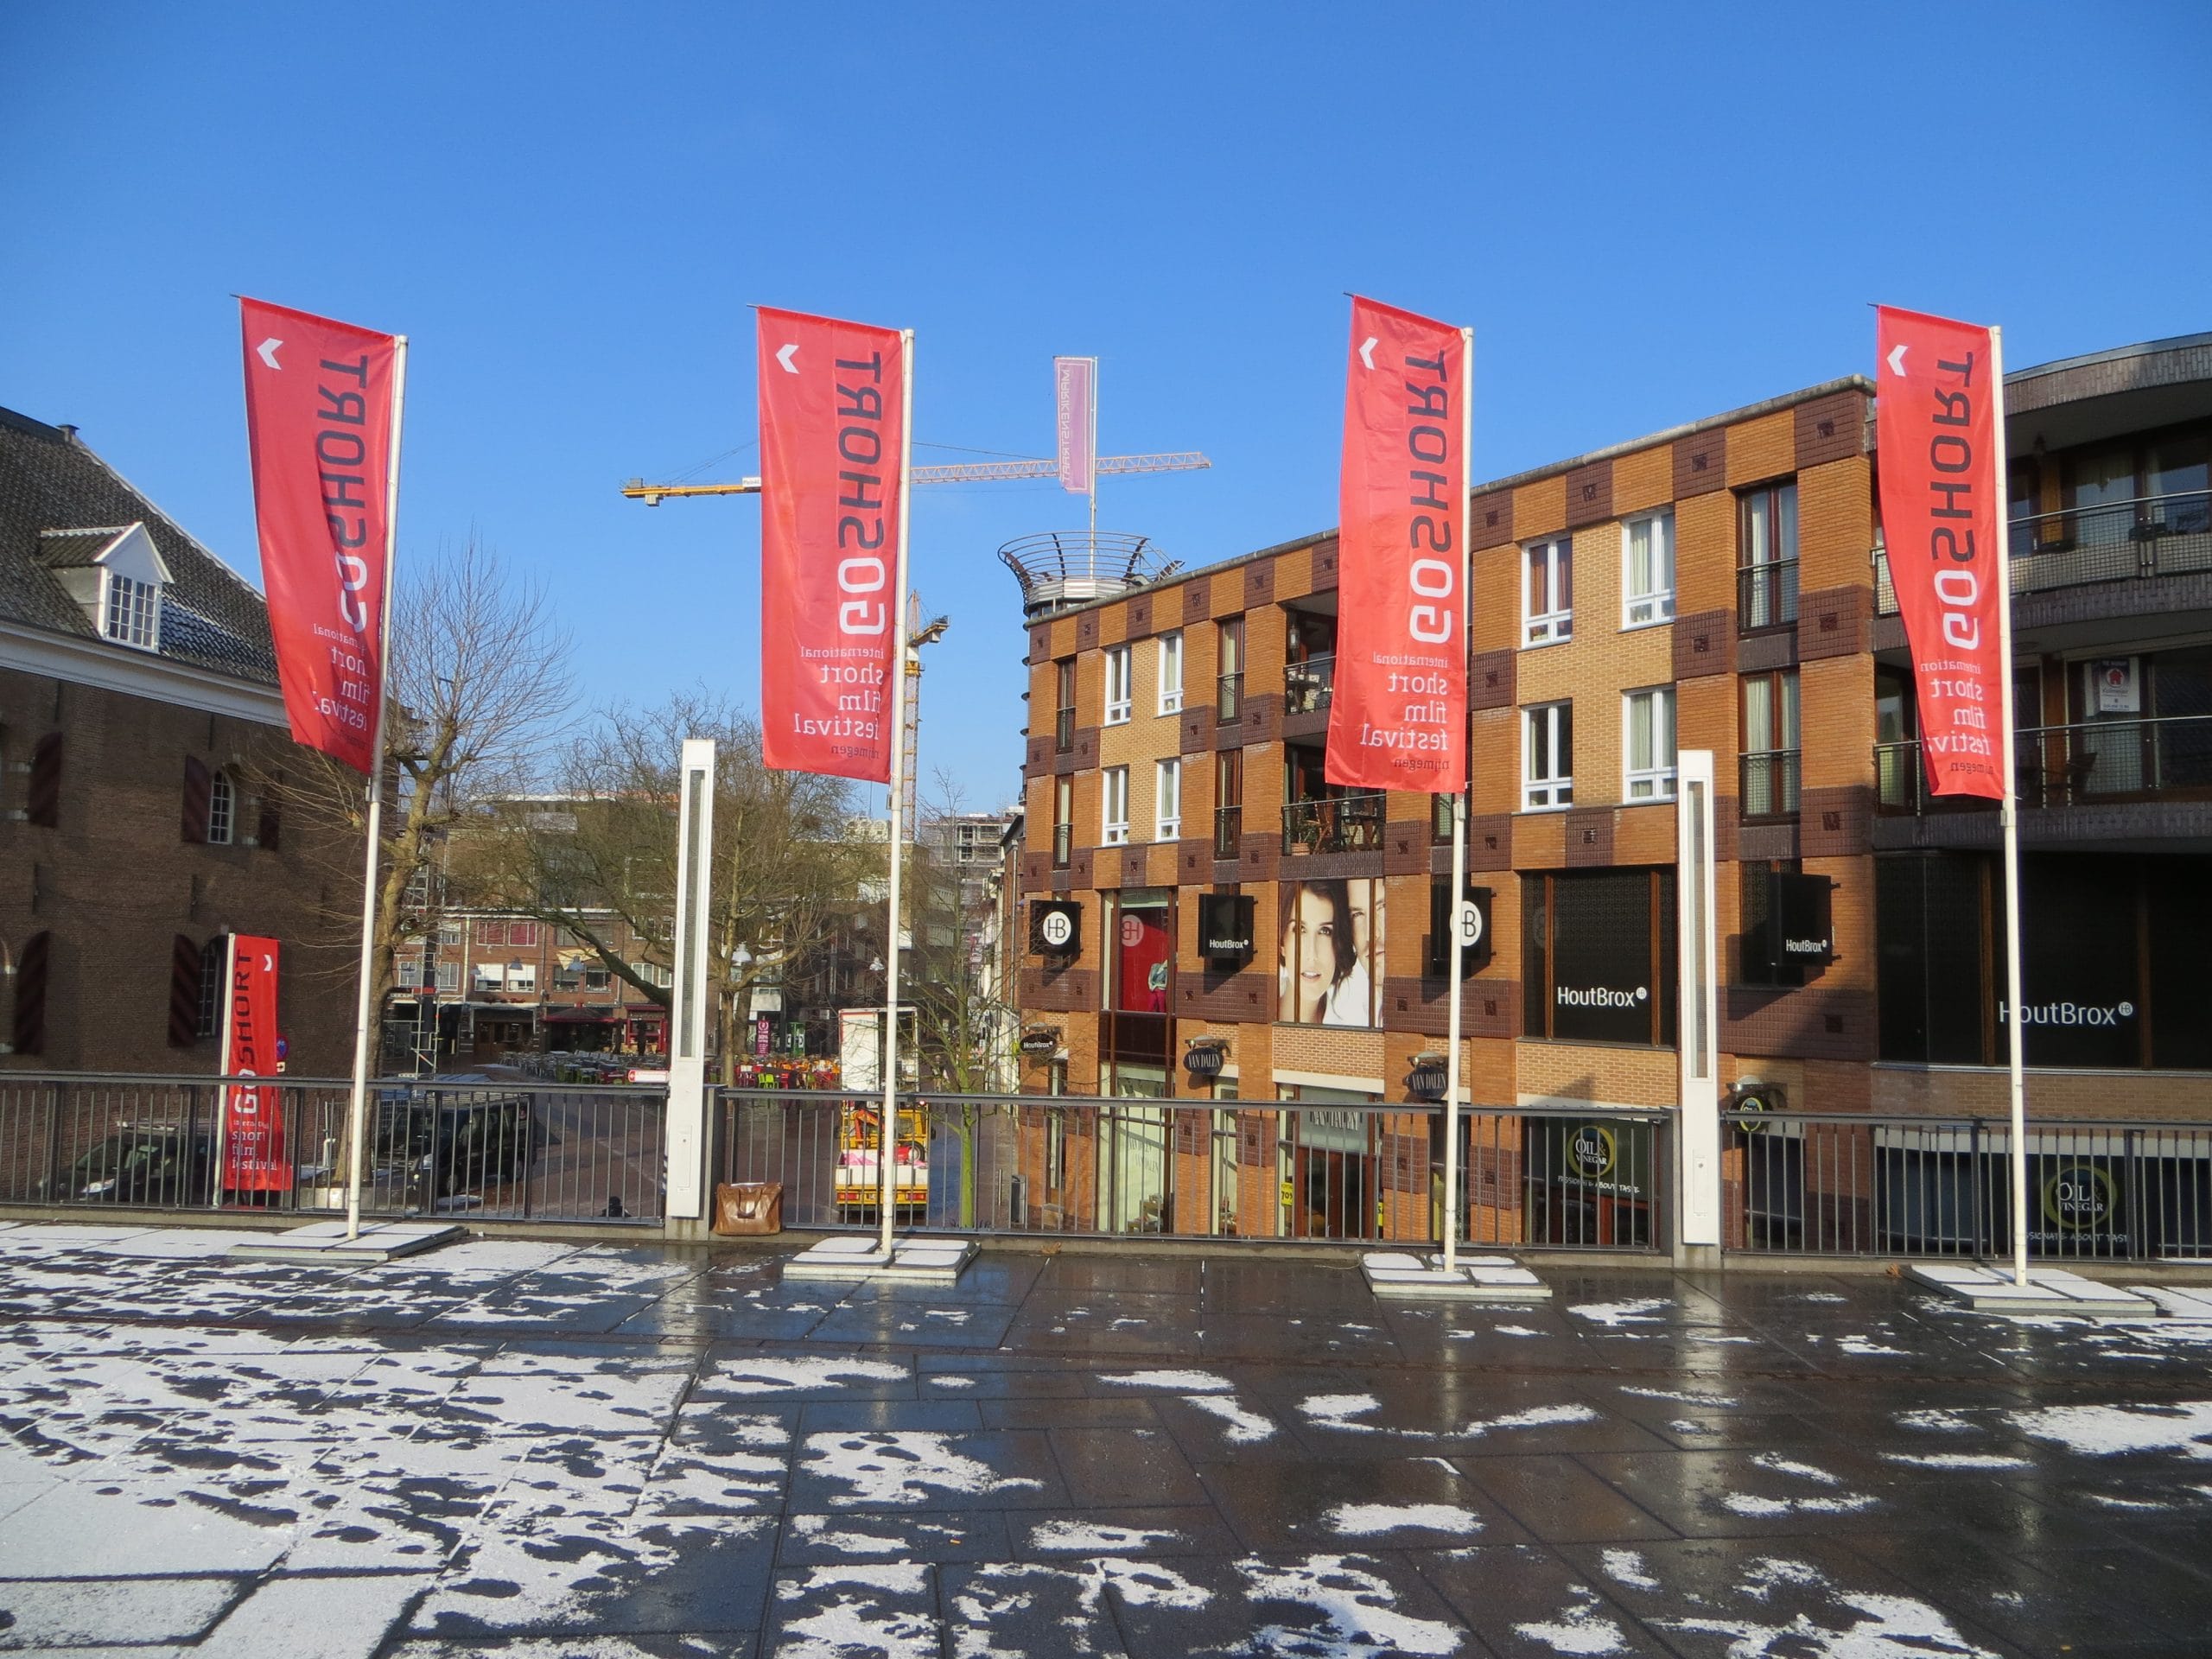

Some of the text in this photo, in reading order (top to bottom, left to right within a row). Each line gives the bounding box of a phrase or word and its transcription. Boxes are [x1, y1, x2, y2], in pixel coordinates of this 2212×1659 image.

[1047, 918, 1066, 938] HB
[1209, 939, 1244, 949] HoutBrox
[1786, 939, 1823, 953] HoutBrox
[1557, 986, 1636, 1007] HoutBrox
[1999, 1001, 2116, 1026] HoutBrox
[1188, 1053, 1220, 1068] VAN DALEN
[1412, 1073, 1446, 1090] VAN DALEN
[1575, 1138, 1598, 1155] OIL
[1575, 1154, 1607, 1166] VINEGAR
